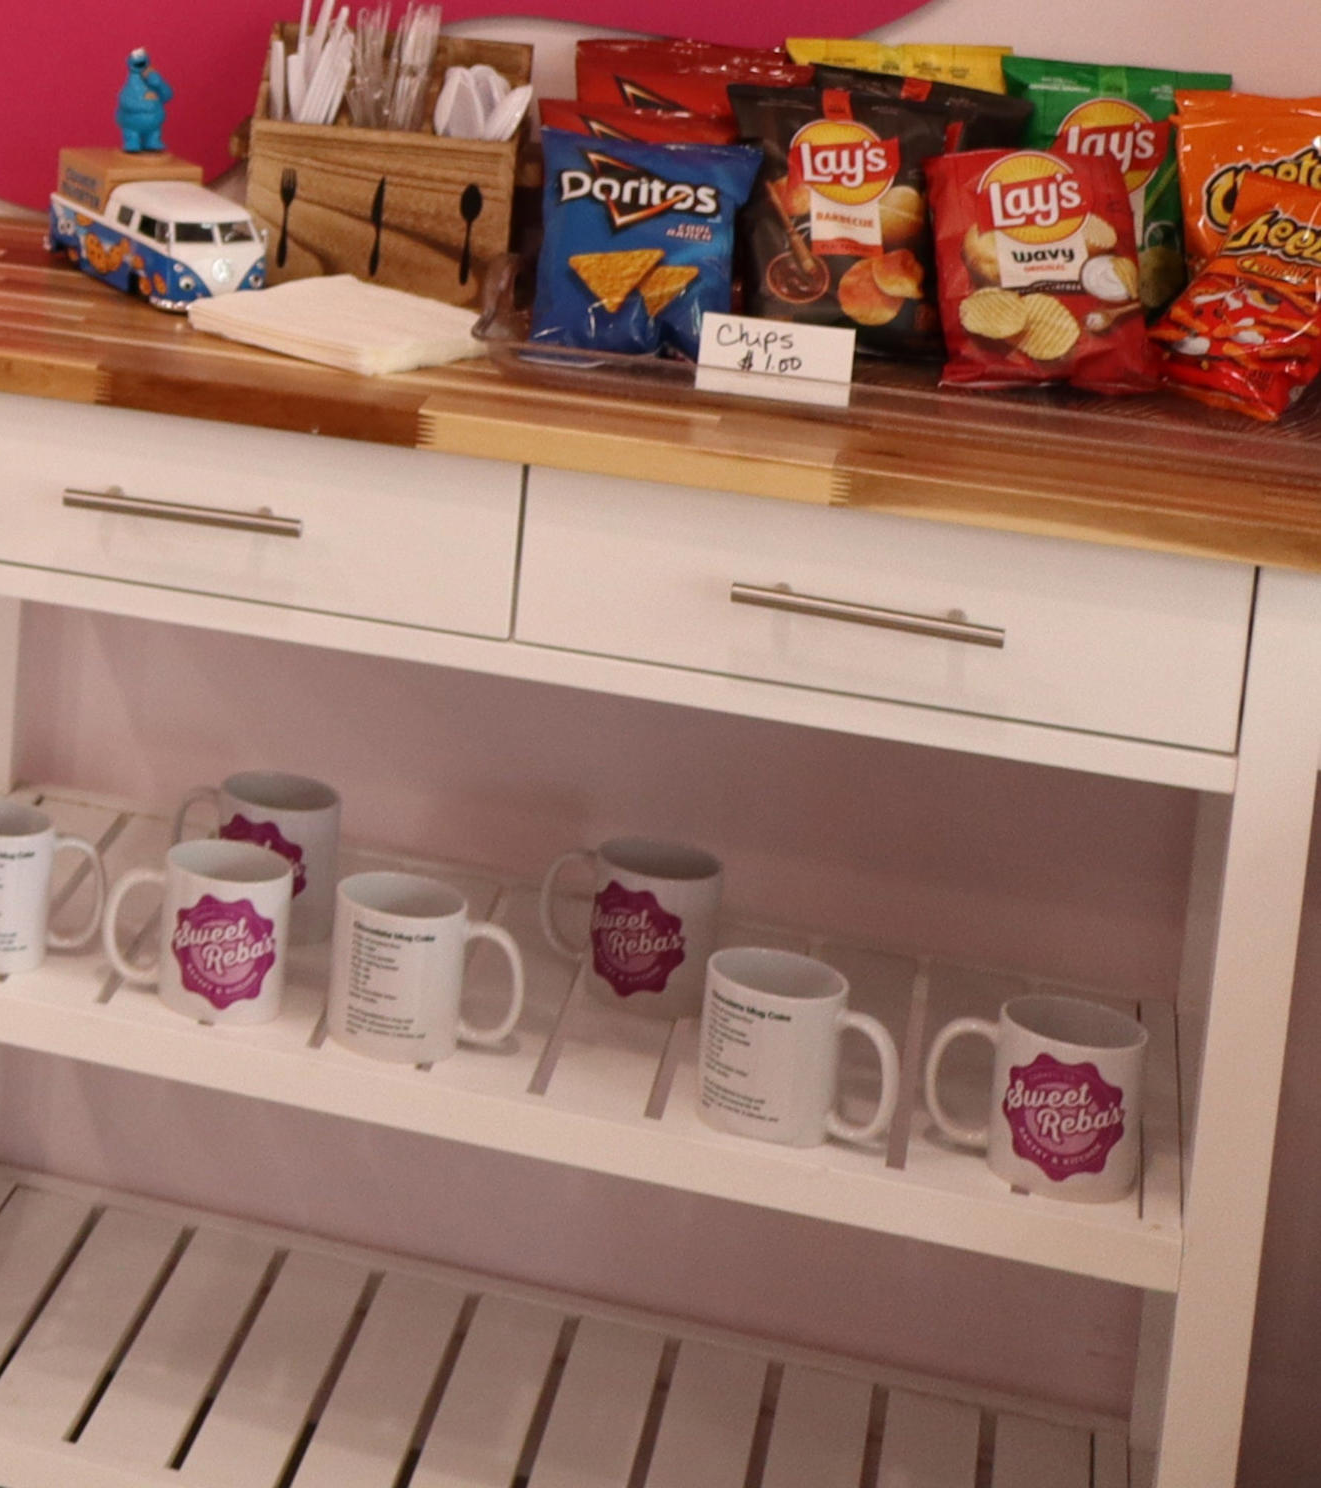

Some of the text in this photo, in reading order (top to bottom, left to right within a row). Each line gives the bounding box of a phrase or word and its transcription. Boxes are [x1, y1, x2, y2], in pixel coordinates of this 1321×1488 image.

[800, 140, 887, 188] Lay's
[560, 169, 719, 214] Doritos
[989, 173, 1082, 228] Lay's
[1011, 247, 1075, 263] wavy
[717, 323, 794, 354] Chips
[176, 917, 248, 950] Sweet
[1007, 1079, 1092, 1111] Sweet
[1037, 1102, 1121, 1143] Reba's
